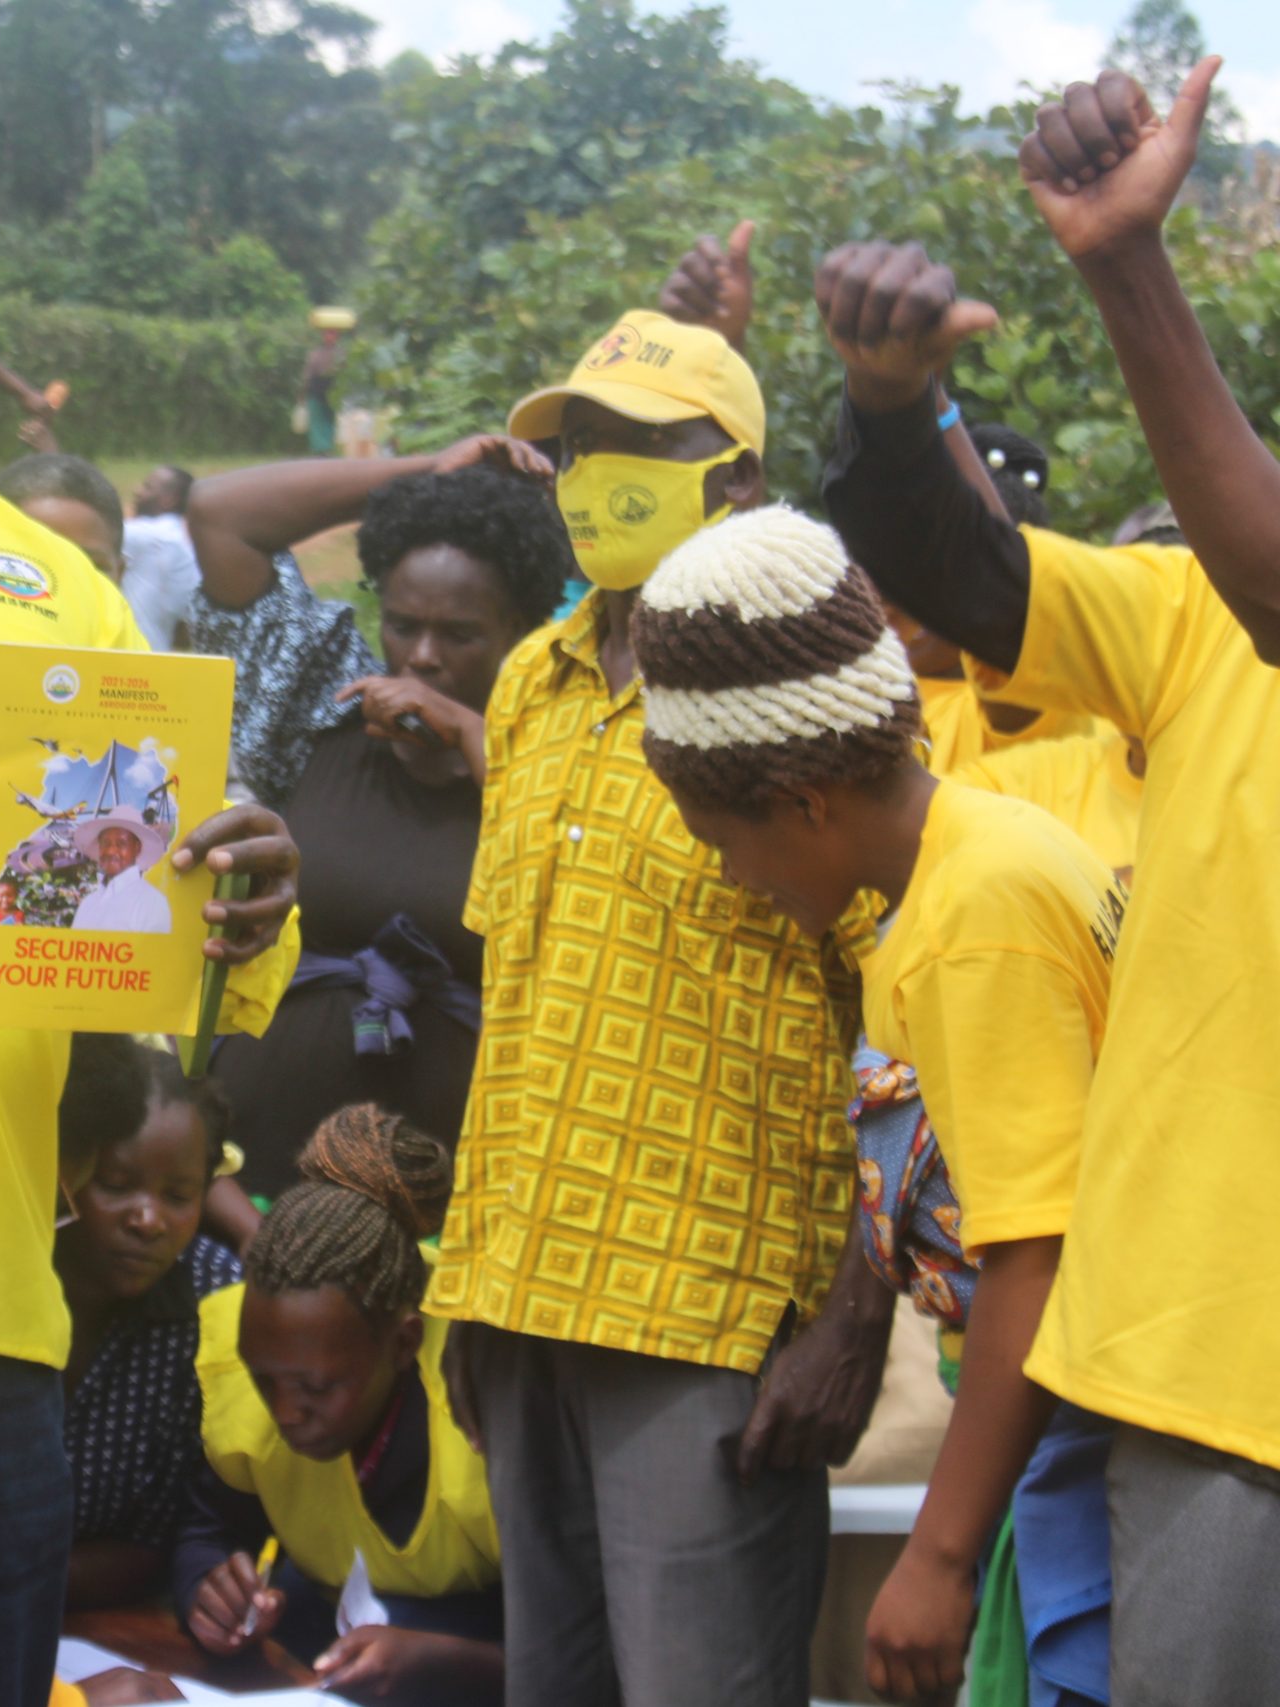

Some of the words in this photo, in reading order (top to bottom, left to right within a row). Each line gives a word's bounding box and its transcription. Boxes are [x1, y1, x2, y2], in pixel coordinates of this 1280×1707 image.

[99, 689, 159, 702] MANIFESTO
[15, 937, 134, 964] SECURING
[65, 967, 151, 992] FUTURE
